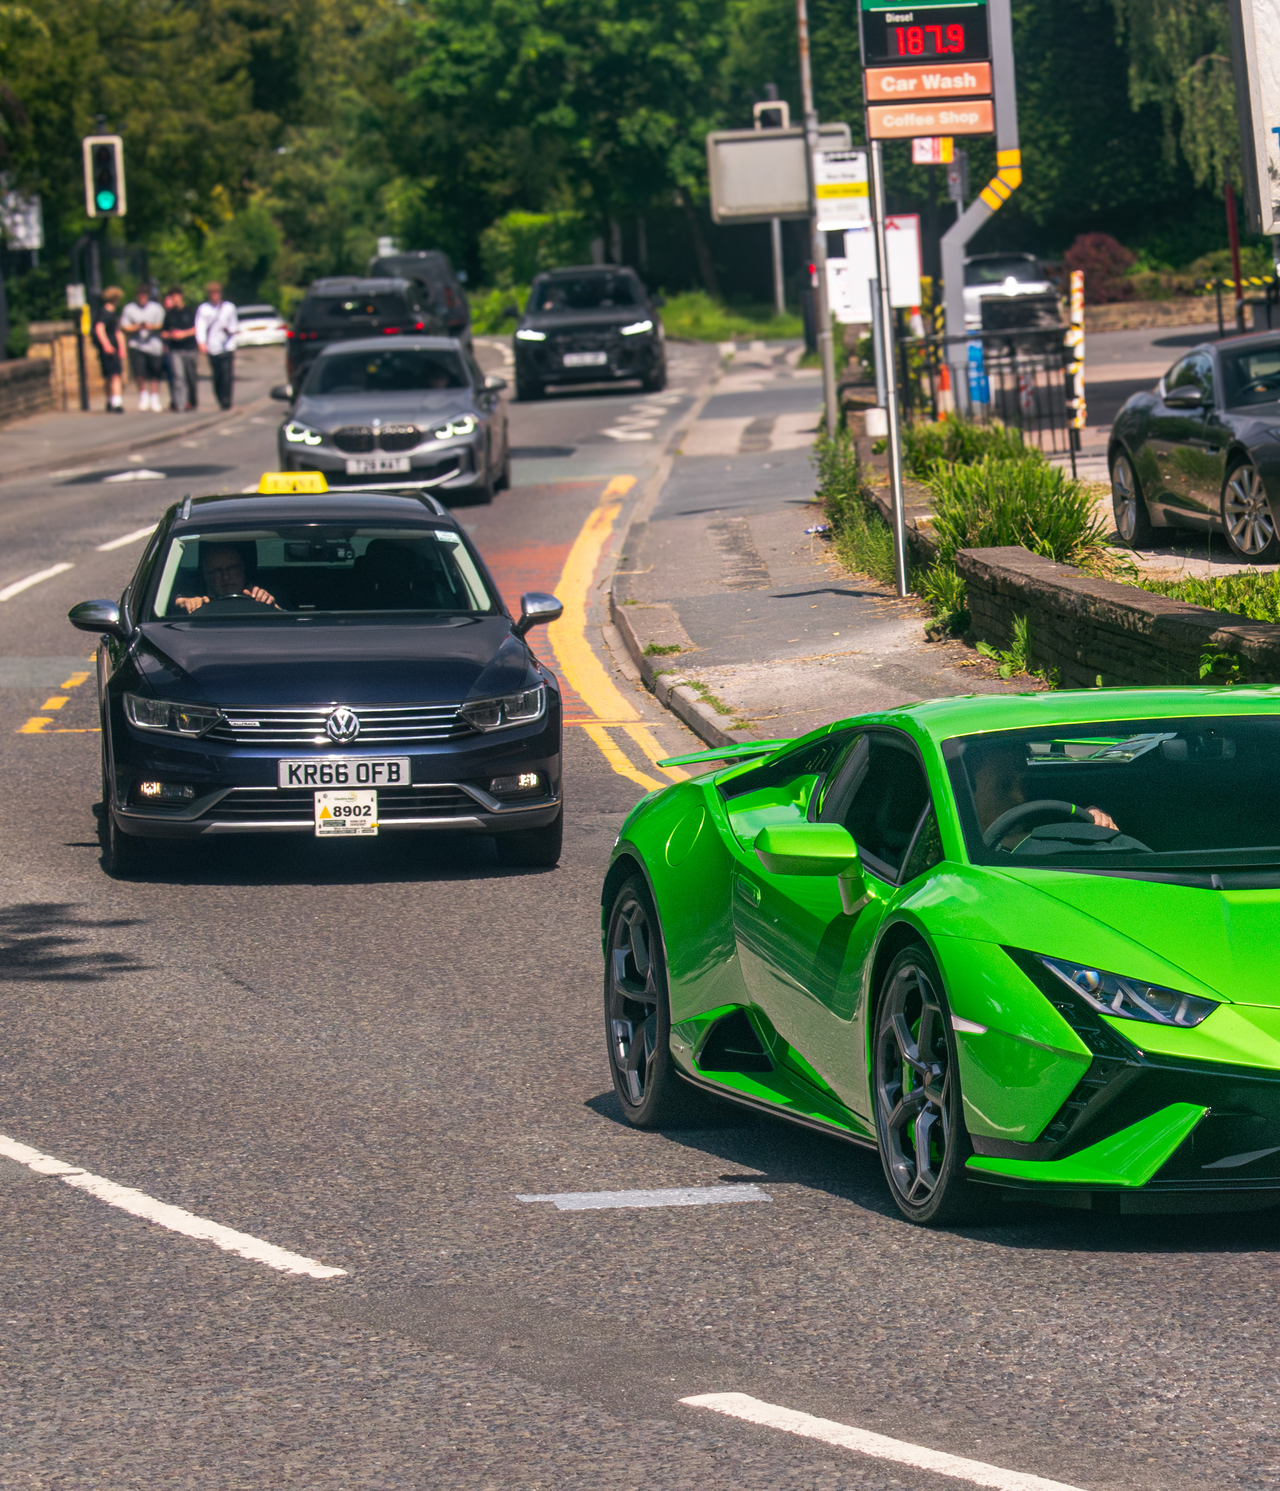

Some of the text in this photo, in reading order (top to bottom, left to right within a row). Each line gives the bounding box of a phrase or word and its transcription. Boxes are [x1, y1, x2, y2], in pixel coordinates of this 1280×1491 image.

[885, 12, 914, 23] Diesel
[895, 24, 965, 56] 187.9
[880, 73, 977, 93] Car Wash
[882, 111, 980, 128] Coffee Shop
[288, 762, 400, 785] KR66 OFB
[333, 805, 372, 817] 8902
